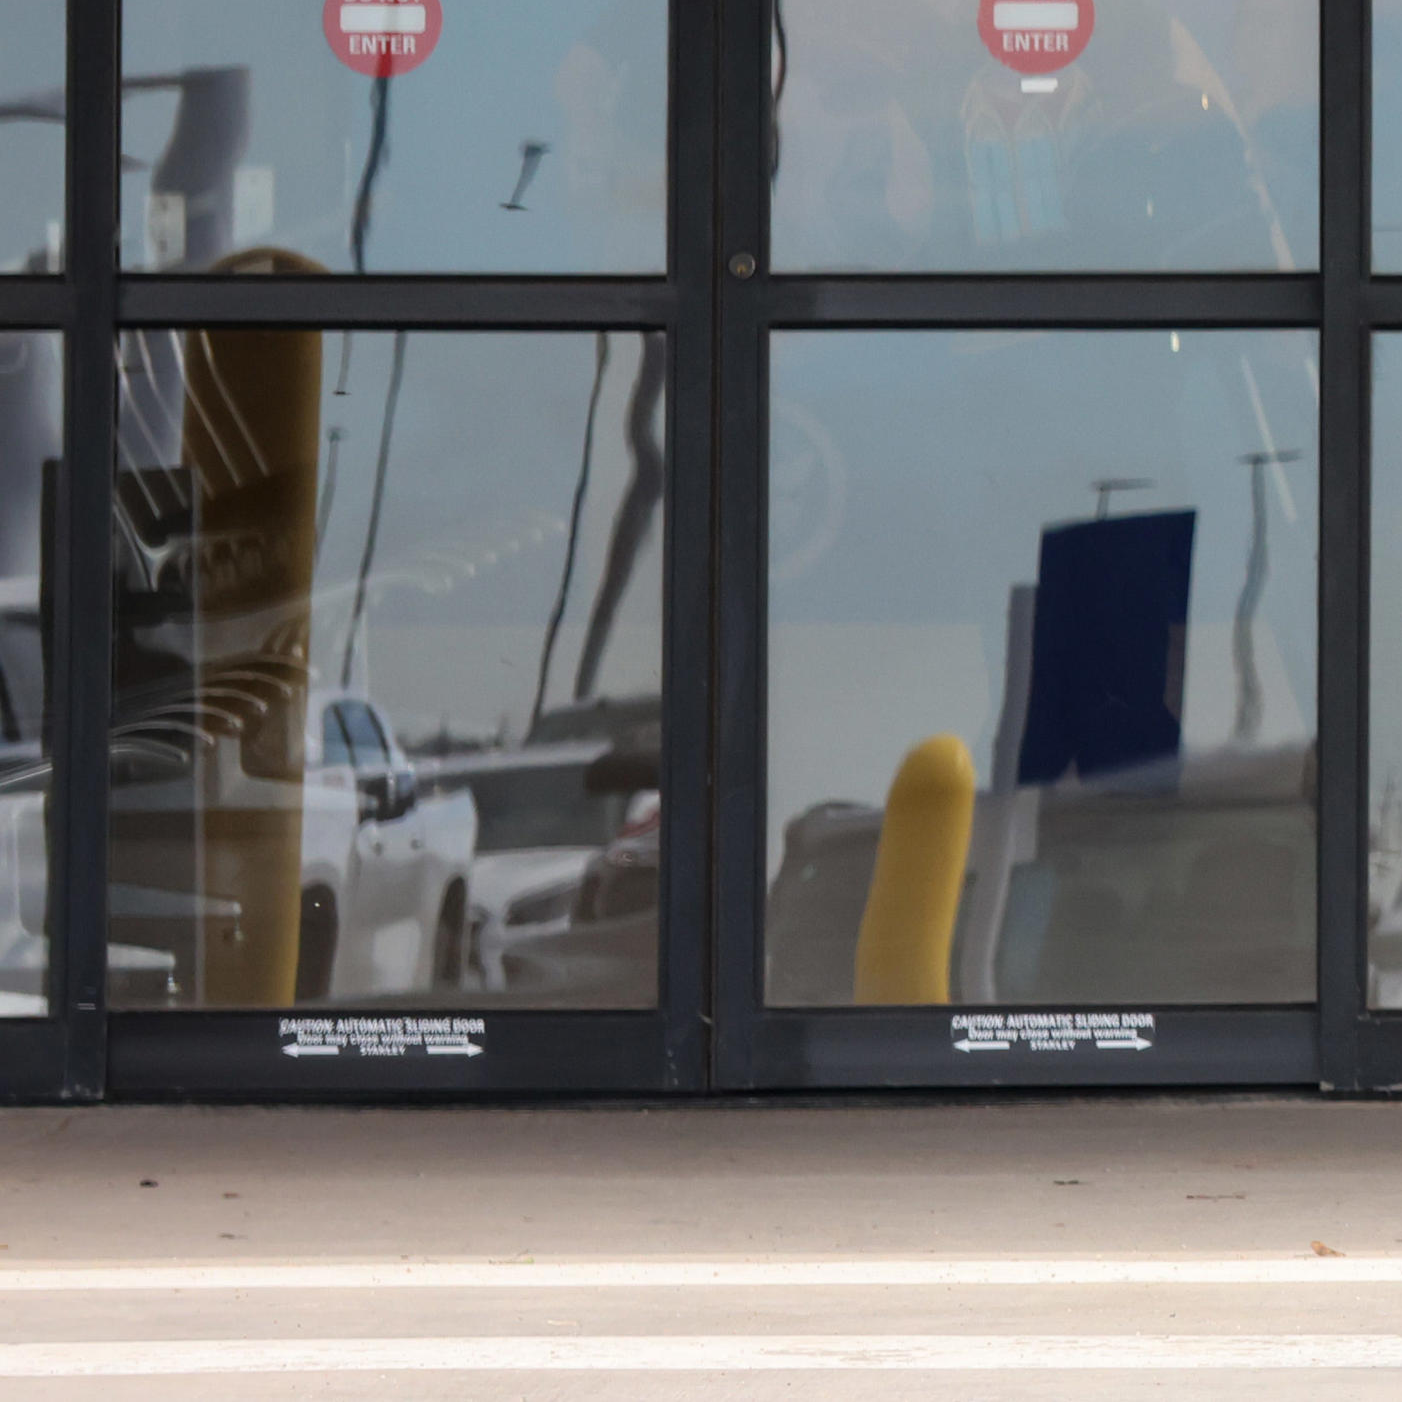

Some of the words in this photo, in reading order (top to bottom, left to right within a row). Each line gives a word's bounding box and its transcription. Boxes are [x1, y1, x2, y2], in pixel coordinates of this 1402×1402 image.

[349, 35, 416, 55] ENTER
[1003, 32, 1069, 52] ENTER
[336, 1019, 403, 1034] AUTOMATIC
[405, 1019, 450, 1034] SLIDING
[452, 1019, 485, 1034] DOOR
[1007, 1015, 1073, 1029] AUTOMATIC
[1074, 1014, 1119, 1028] SLIDING
[1121, 1014, 1153, 1028] DOOR
[325, 1034, 348, 1048] may
[381, 1032, 422, 1045] without
[423, 1033, 469, 1046] warning
[995, 1029, 1018, 1043] may
[1050, 1028, 1092, 1040] without
[1093, 1029, 1138, 1041] warning
